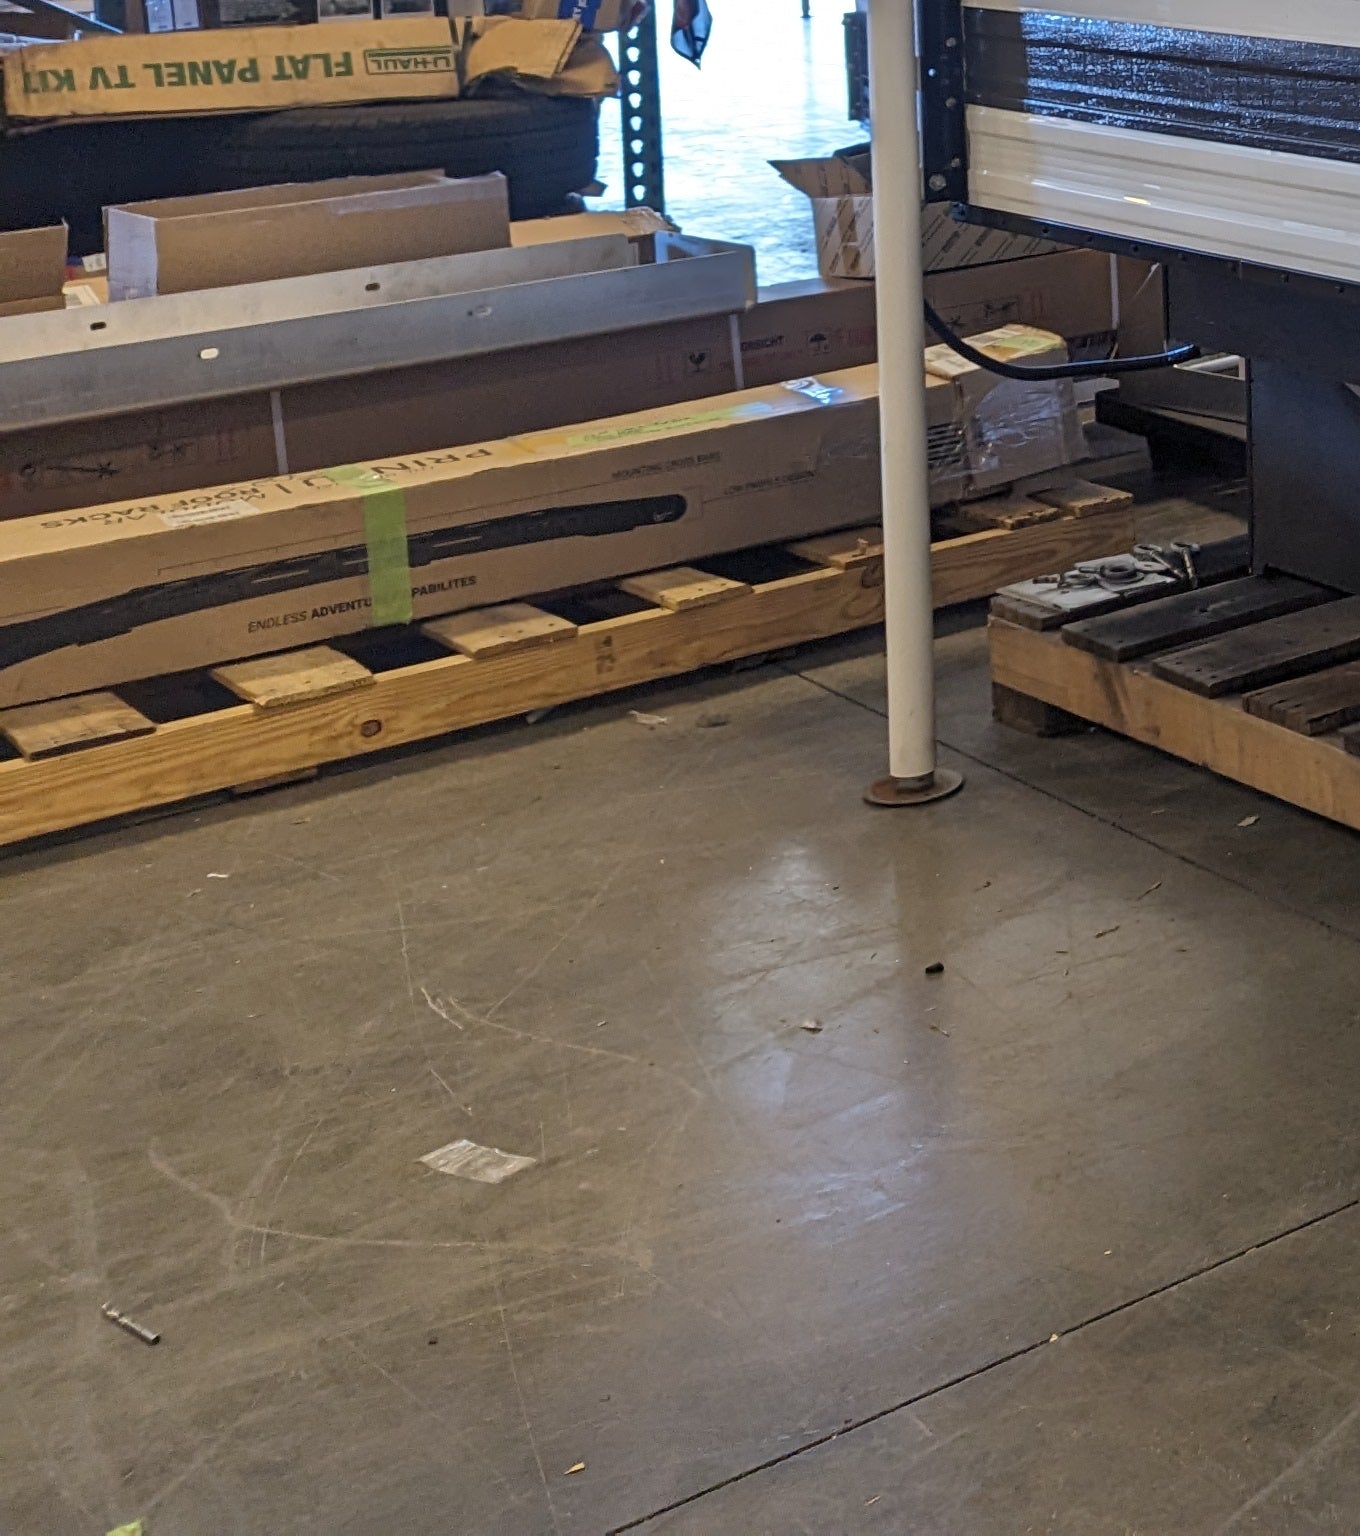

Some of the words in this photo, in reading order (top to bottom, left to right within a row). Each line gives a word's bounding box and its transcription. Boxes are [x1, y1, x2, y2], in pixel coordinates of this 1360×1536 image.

[89, 64, 136, 92] TV
[143, 57, 261, 88] PANEL
[271, 51, 355, 80] FLAT
[370, 56, 451, 73] U-HAUL
[22, 68, 77, 96] KIT
[40, 502, 161, 530] RACKS
[247, 609, 308, 634] ENDLESS
[310, 596, 373, 620] ADVENTU
